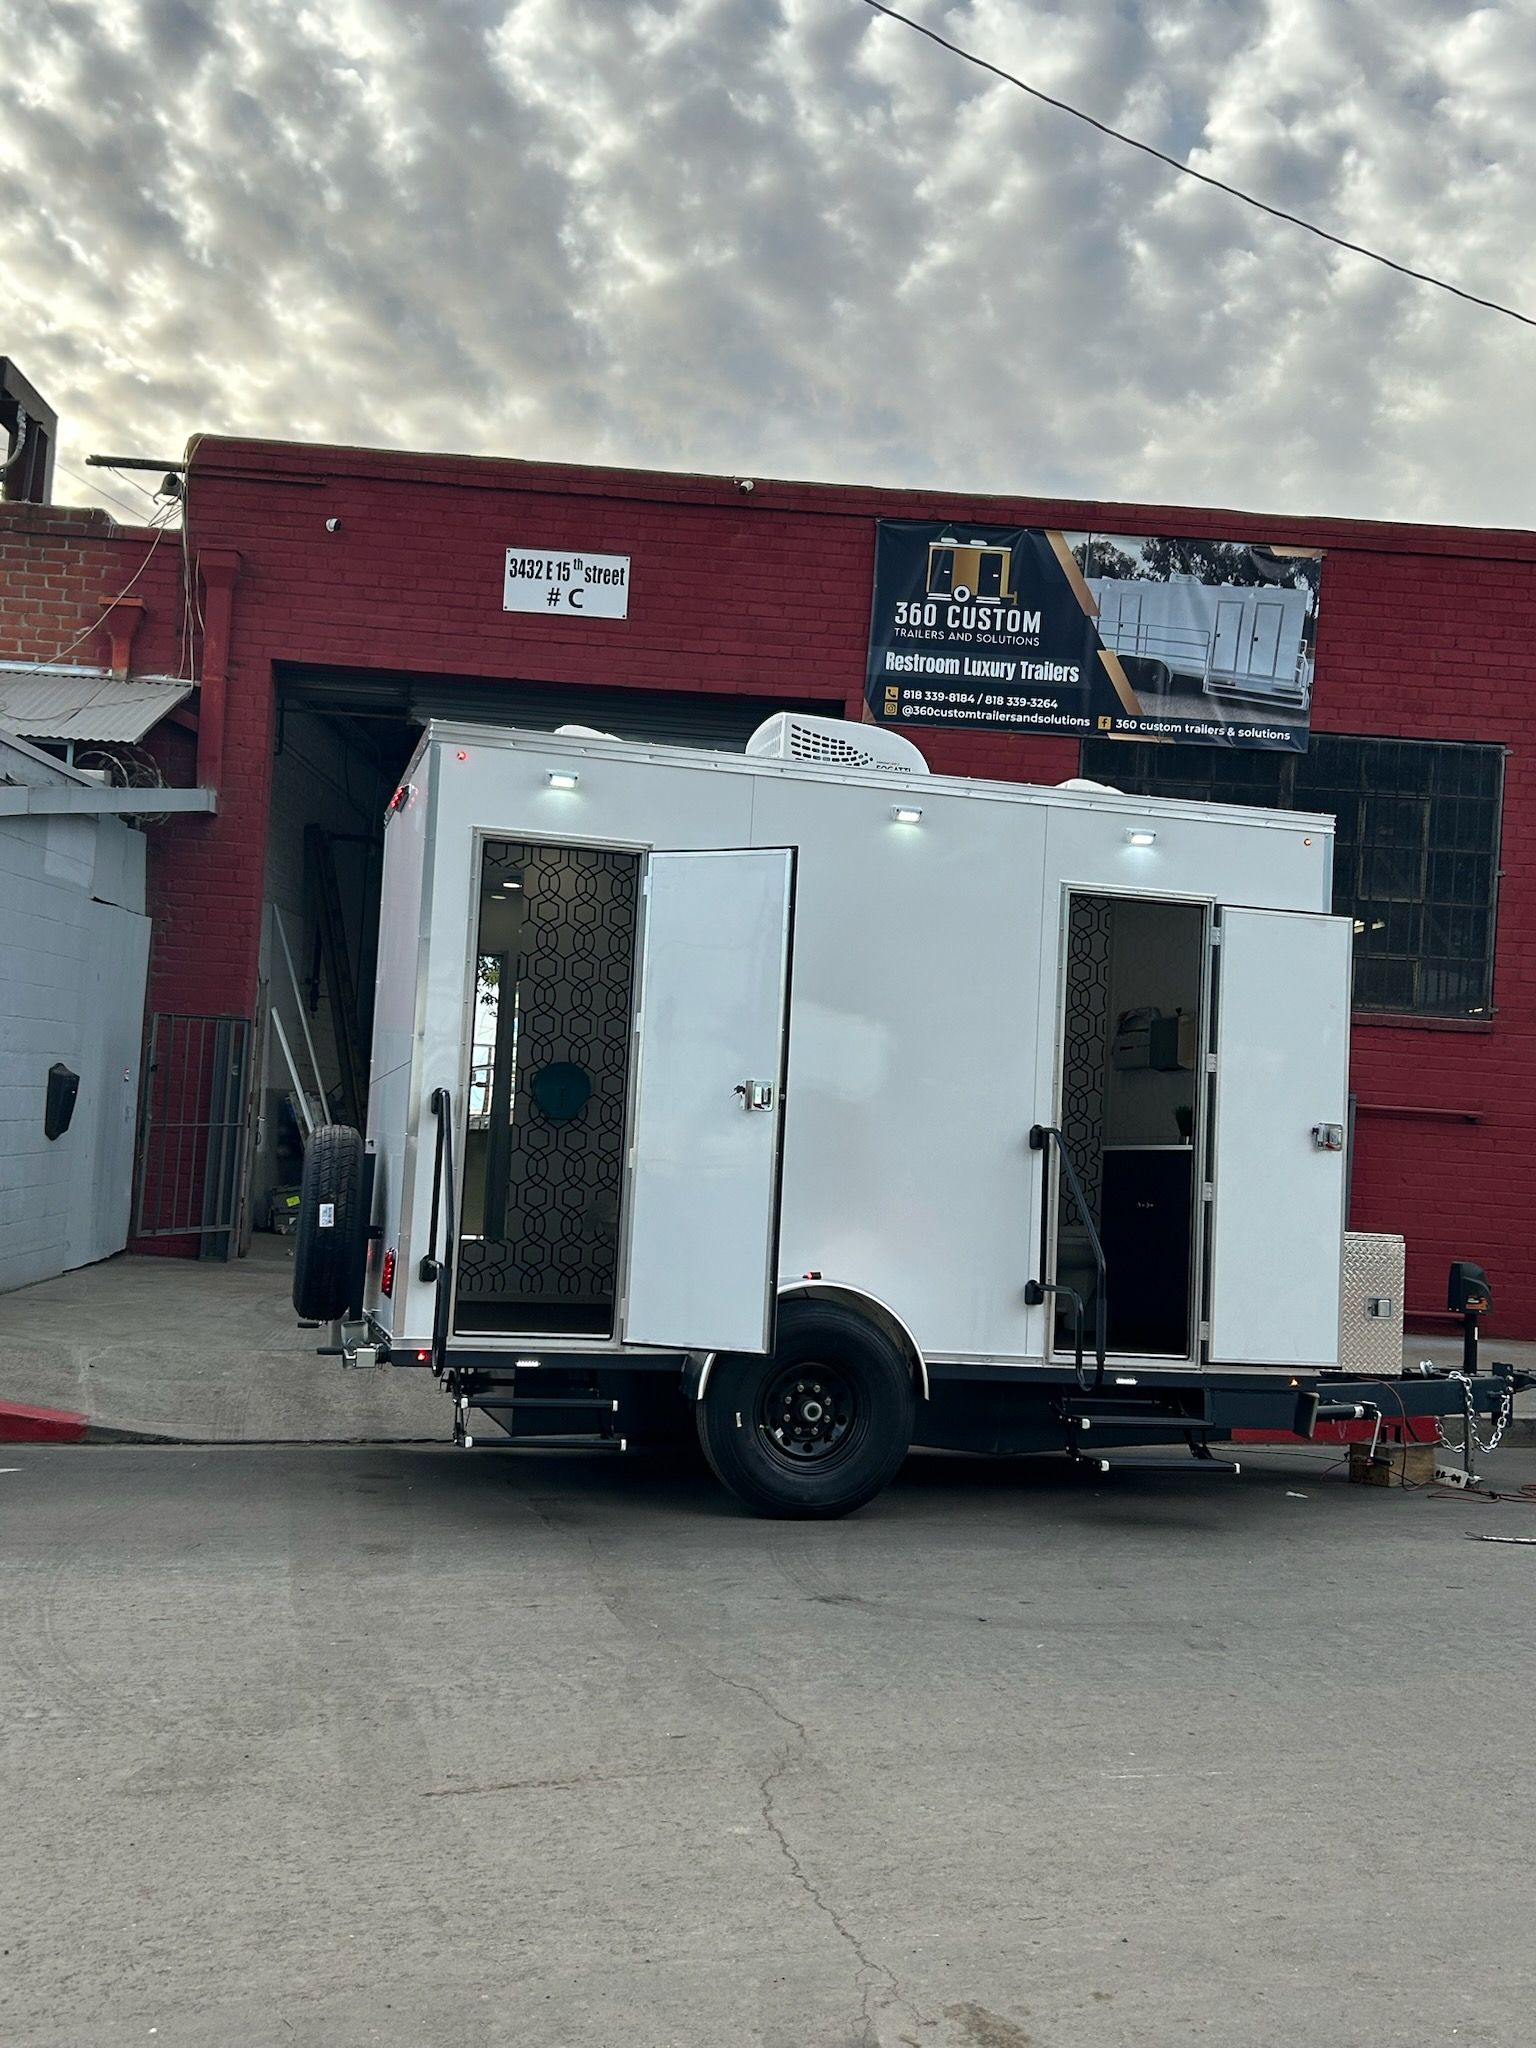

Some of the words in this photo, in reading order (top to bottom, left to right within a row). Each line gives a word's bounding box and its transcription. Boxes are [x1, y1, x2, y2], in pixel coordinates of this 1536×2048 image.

[509, 558, 543, 579] 3432
[546, 560, 553, 580] E
[584, 566, 625, 585] street
[547, 587, 561, 606] #
[568, 588, 584, 608] C
[894, 601, 937, 627] 360
[946, 605, 1042, 634] CUSTOM
[894, 627, 945, 640] TRAILERS
[948, 632, 973, 642] AND
[976, 634, 1040, 647] SOLUTIONS
[885, 651, 960, 675] Restroom
[963, 657, 1017, 681] Luxury
[1020, 661, 1080, 683] Trailers
[903, 690, 922, 700] 818
[925, 691, 975, 704] 339-8184
[984, 695, 1004, 706] 818
[1007, 697, 1058, 709] 339-3264
[902, 705, 1091, 727] @360customtrailersandsolutions
[1115, 719, 1137, 730] 360
[1139, 723, 1182, 733] custom
[1184, 725, 1225, 736] trailers
[1226, 729, 1236, 739] &
[1237, 728, 1291, 741] solutions
